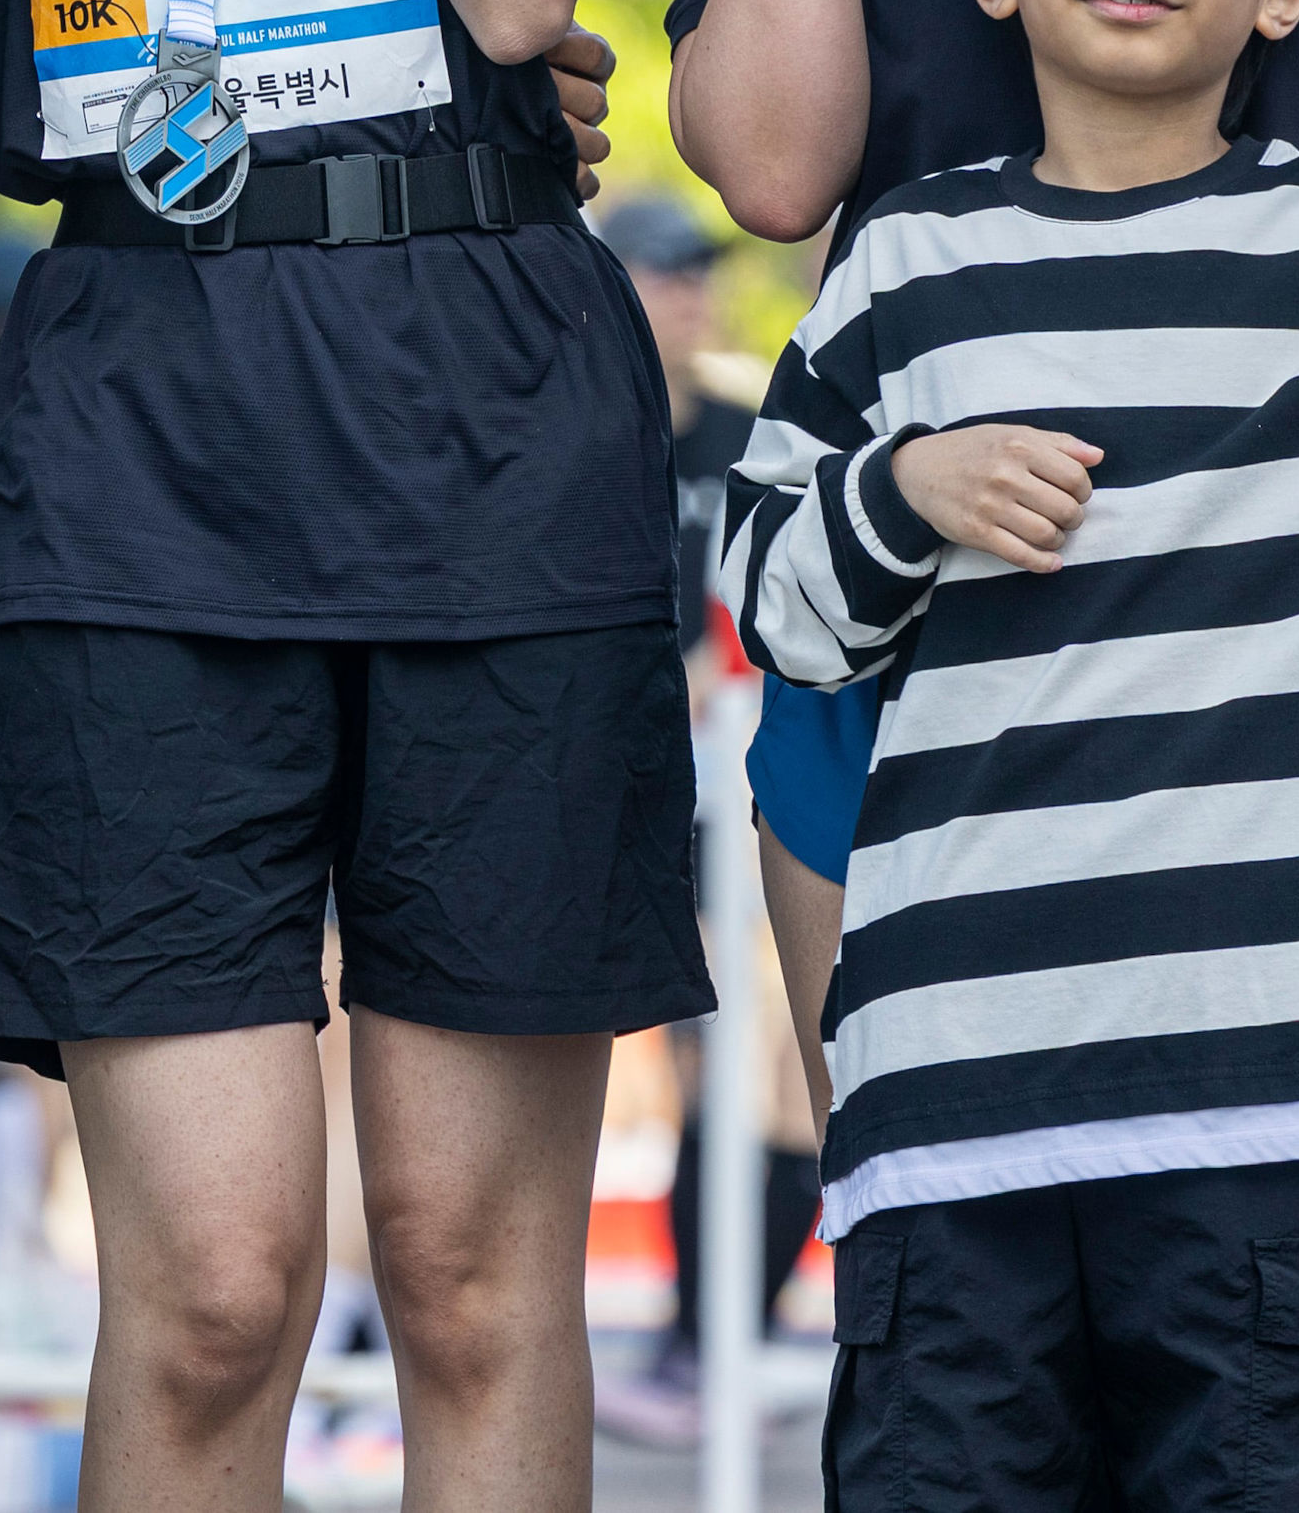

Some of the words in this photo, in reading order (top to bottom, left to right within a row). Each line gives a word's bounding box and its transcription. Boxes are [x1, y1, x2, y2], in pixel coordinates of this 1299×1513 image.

[238, 29, 265, 45] HALF
[268, 20, 327, 41] MARATHON
[212, 63, 351, 116] 울특별시
[189, 213, 206, 222] SEOUL
